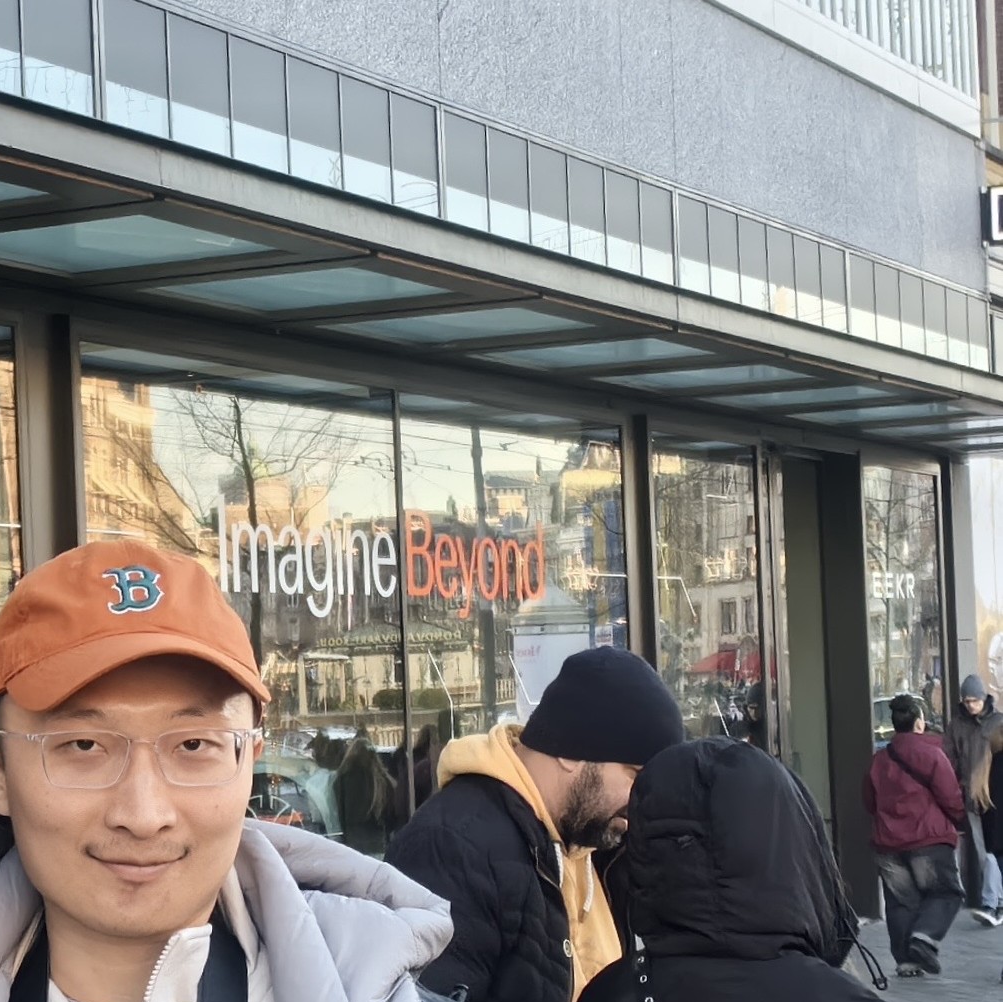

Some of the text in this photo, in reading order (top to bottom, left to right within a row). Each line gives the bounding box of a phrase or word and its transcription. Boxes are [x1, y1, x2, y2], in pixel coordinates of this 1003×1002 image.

[101, 565, 165, 615] B
[217, 494, 546, 619] Imagine Beyond
